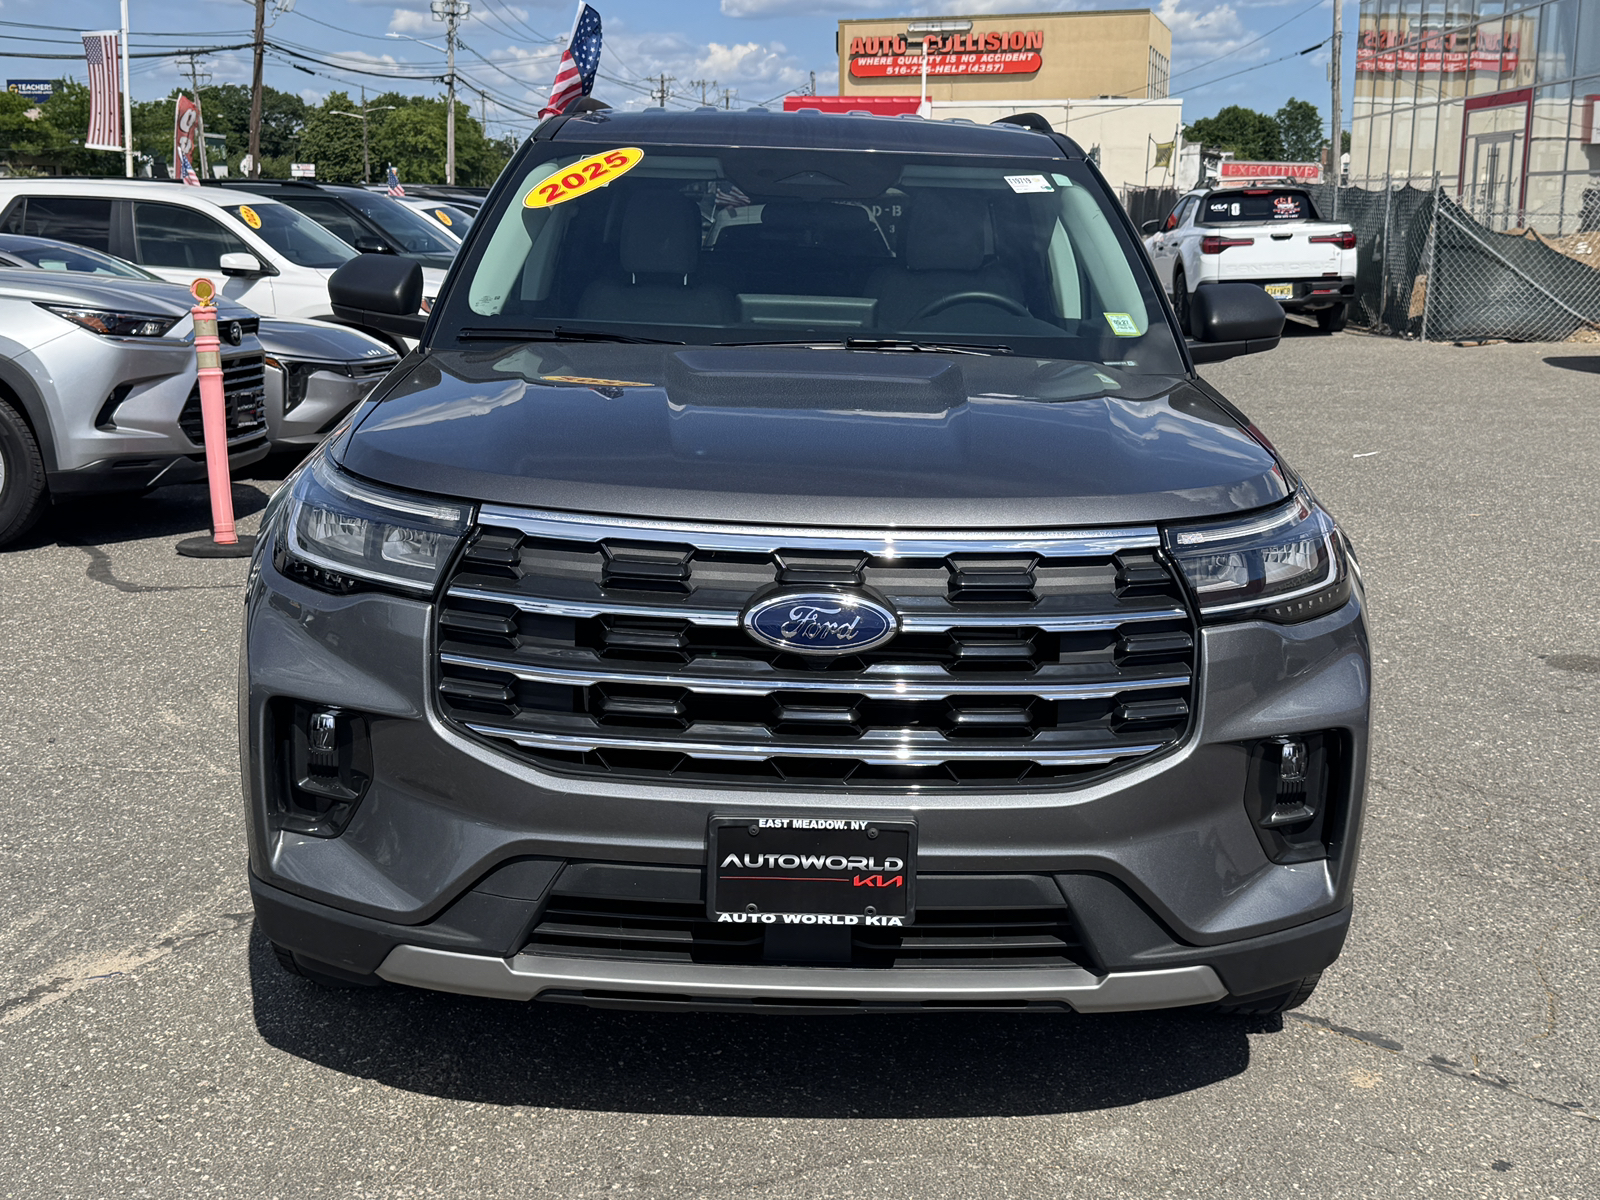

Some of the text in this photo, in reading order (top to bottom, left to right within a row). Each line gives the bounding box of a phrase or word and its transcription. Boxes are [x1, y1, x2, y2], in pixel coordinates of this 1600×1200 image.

[850, 31, 1043, 54] AUTO COLLISION
[857, 57, 893, 66] WHERE
[945, 54, 957, 63] IS
[961, 53, 976, 62] NO
[980, 52, 1034, 63] ACCIDENT
[967, 62, 1004, 73] (4357)
[538, 151, 630, 203] 2025
[1228, 164, 1315, 178] EXECUTIVE
[781, 605, 861, 640] Ford
[759, 819, 789, 828] EAST
[851, 821, 868, 831] NY
[720, 853, 904, 872] AUTOWORLD
[853, 874, 903, 888] KIA
[718, 913, 903, 926] AUTO WORLD KIA
